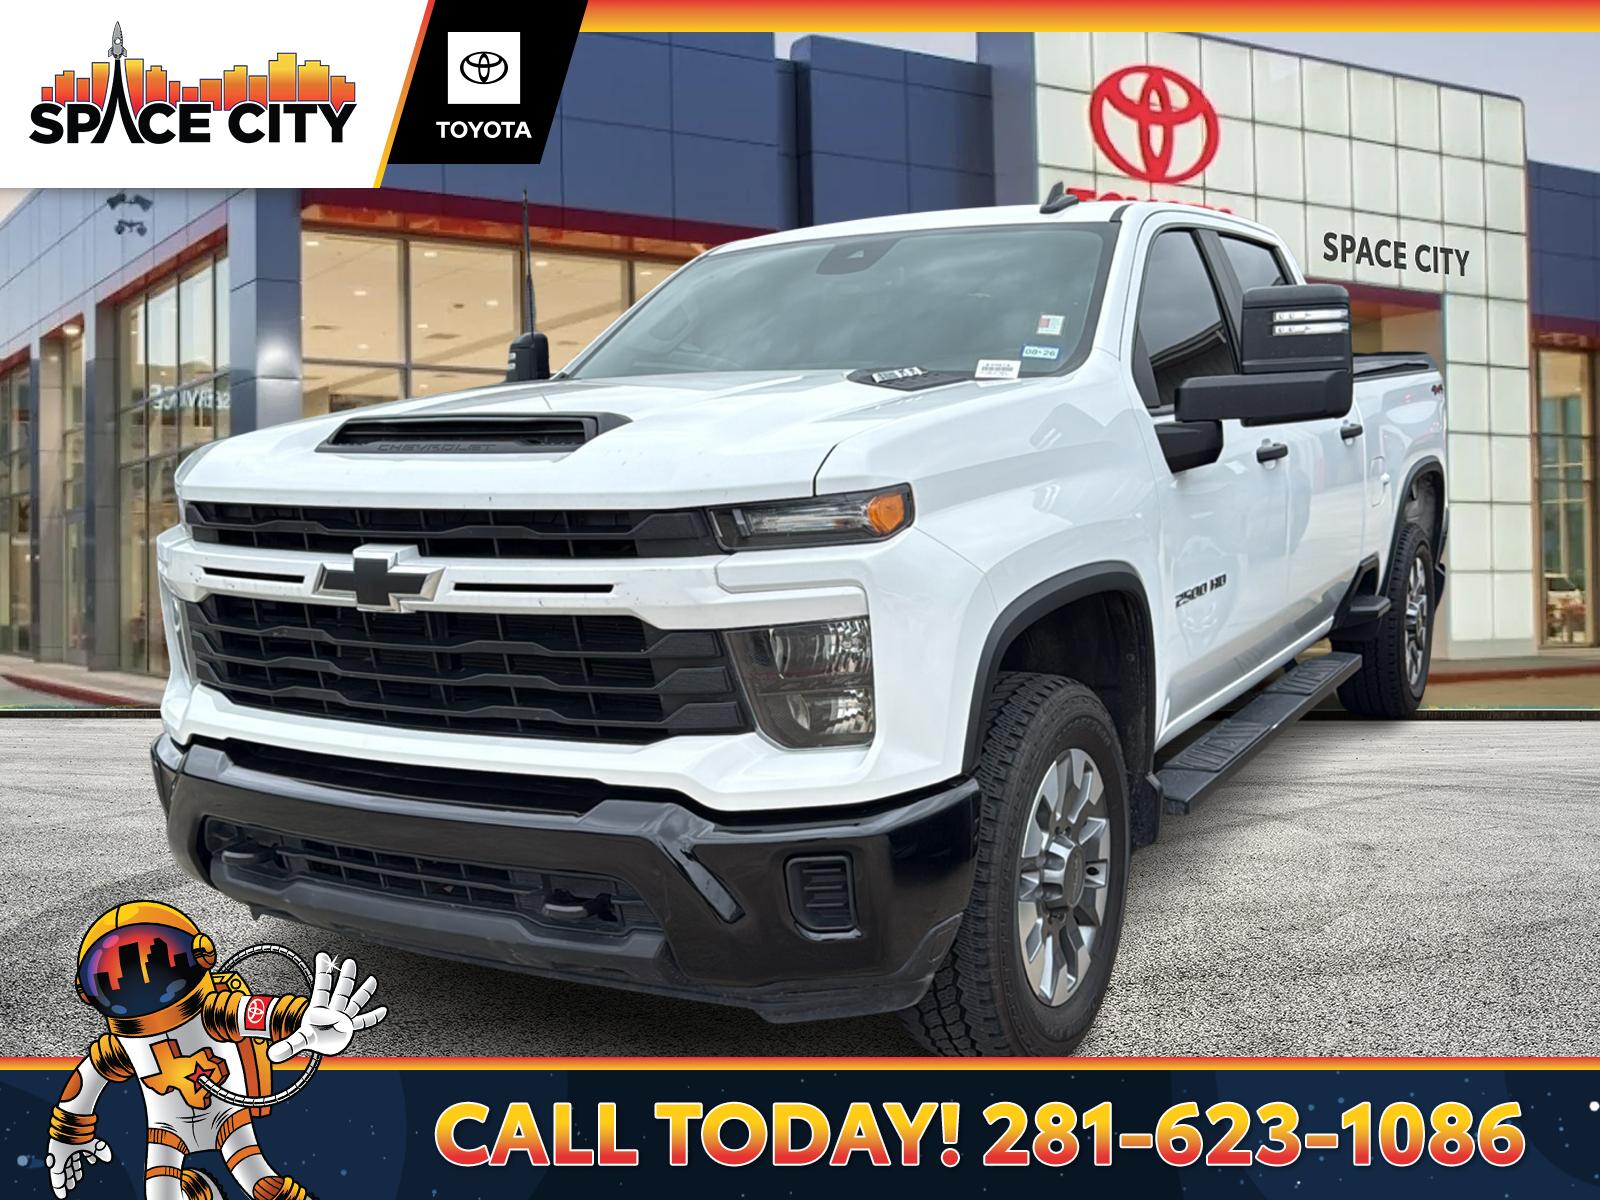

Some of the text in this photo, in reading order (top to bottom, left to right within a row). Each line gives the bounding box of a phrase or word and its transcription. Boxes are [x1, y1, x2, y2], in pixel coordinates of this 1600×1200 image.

[1323, 232, 1470, 276] SPACE CITY
[1175, 574, 1226, 608] 2500 HD
